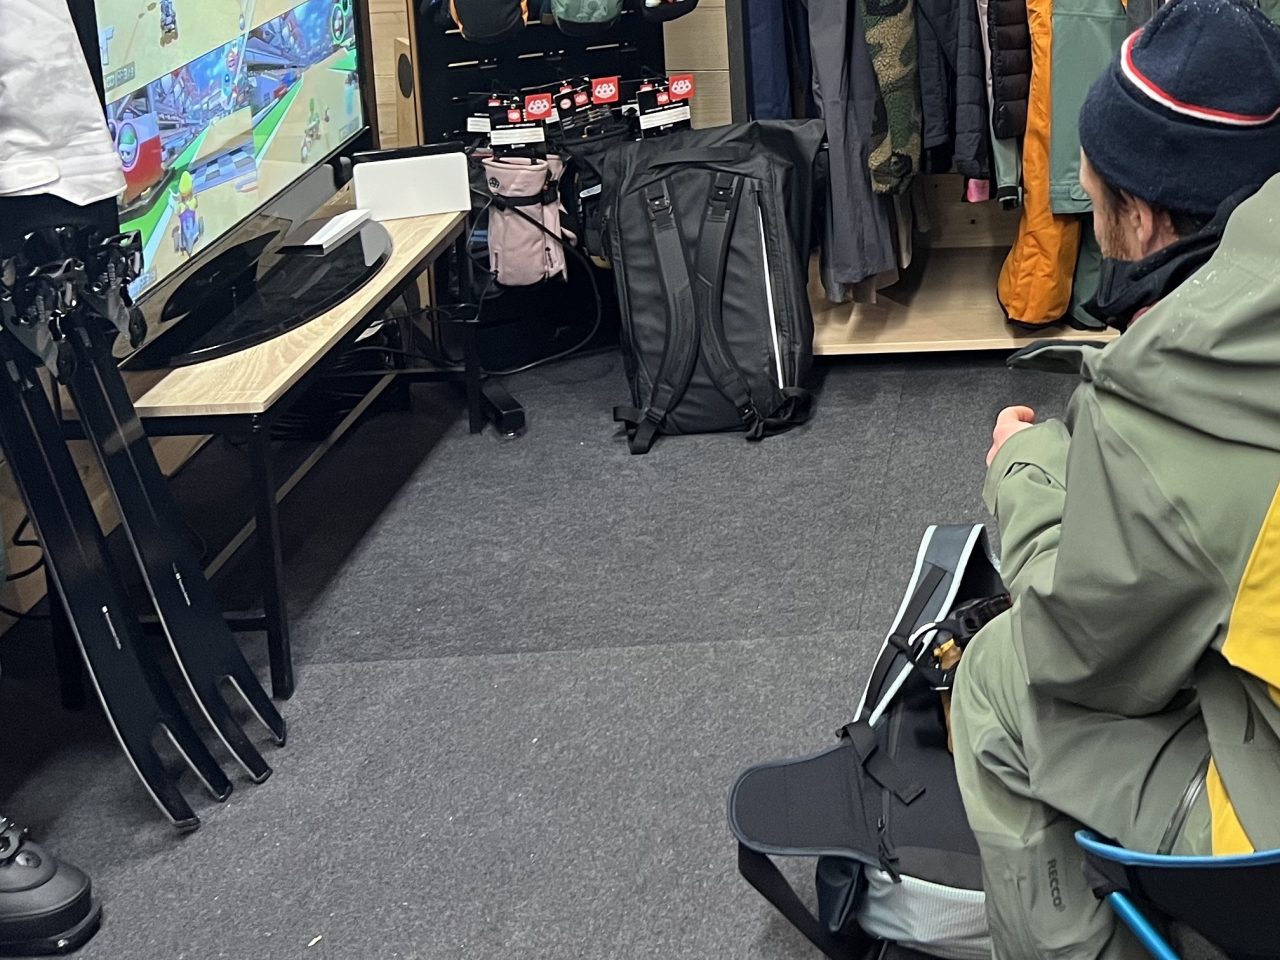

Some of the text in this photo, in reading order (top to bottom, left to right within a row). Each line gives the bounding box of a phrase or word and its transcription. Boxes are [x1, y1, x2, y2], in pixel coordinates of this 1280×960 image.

[594, 83, 616, 98] 686
[671, 80, 692, 94] 686
[527, 98, 550, 114] 686
[1047, 858, 1062, 907] RECCO
